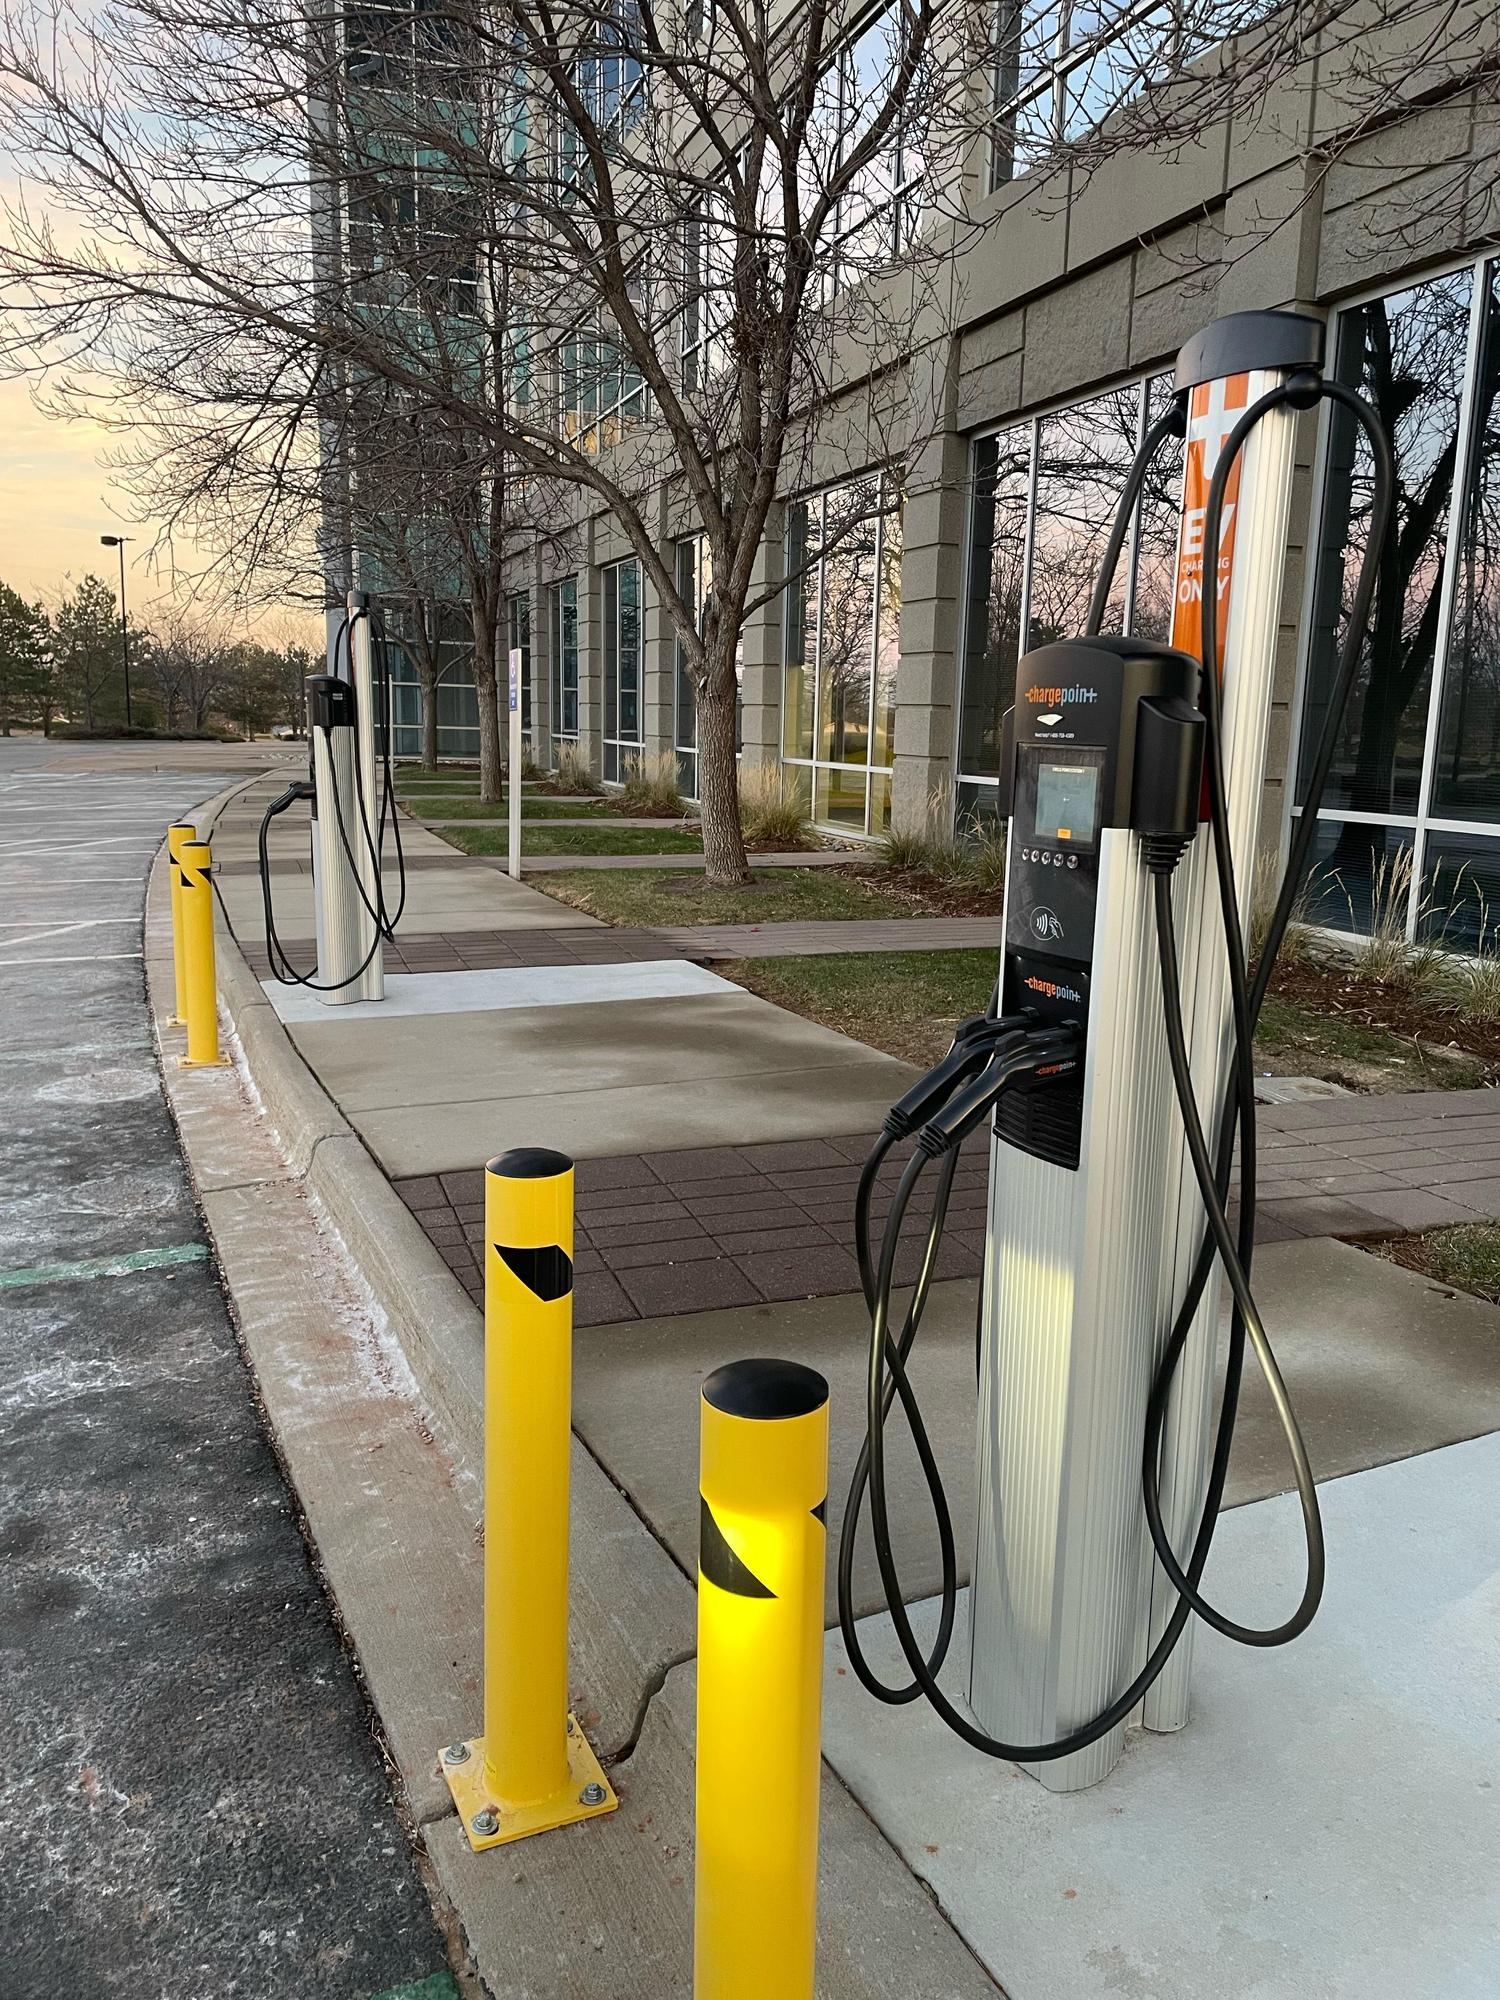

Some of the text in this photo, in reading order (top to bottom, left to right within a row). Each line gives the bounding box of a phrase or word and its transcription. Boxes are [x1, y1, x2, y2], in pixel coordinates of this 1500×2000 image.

[1183, 504, 1235, 555] EV
[1181, 557, 1230, 573] CHARNG
[1179, 576, 1230, 603] ONY
